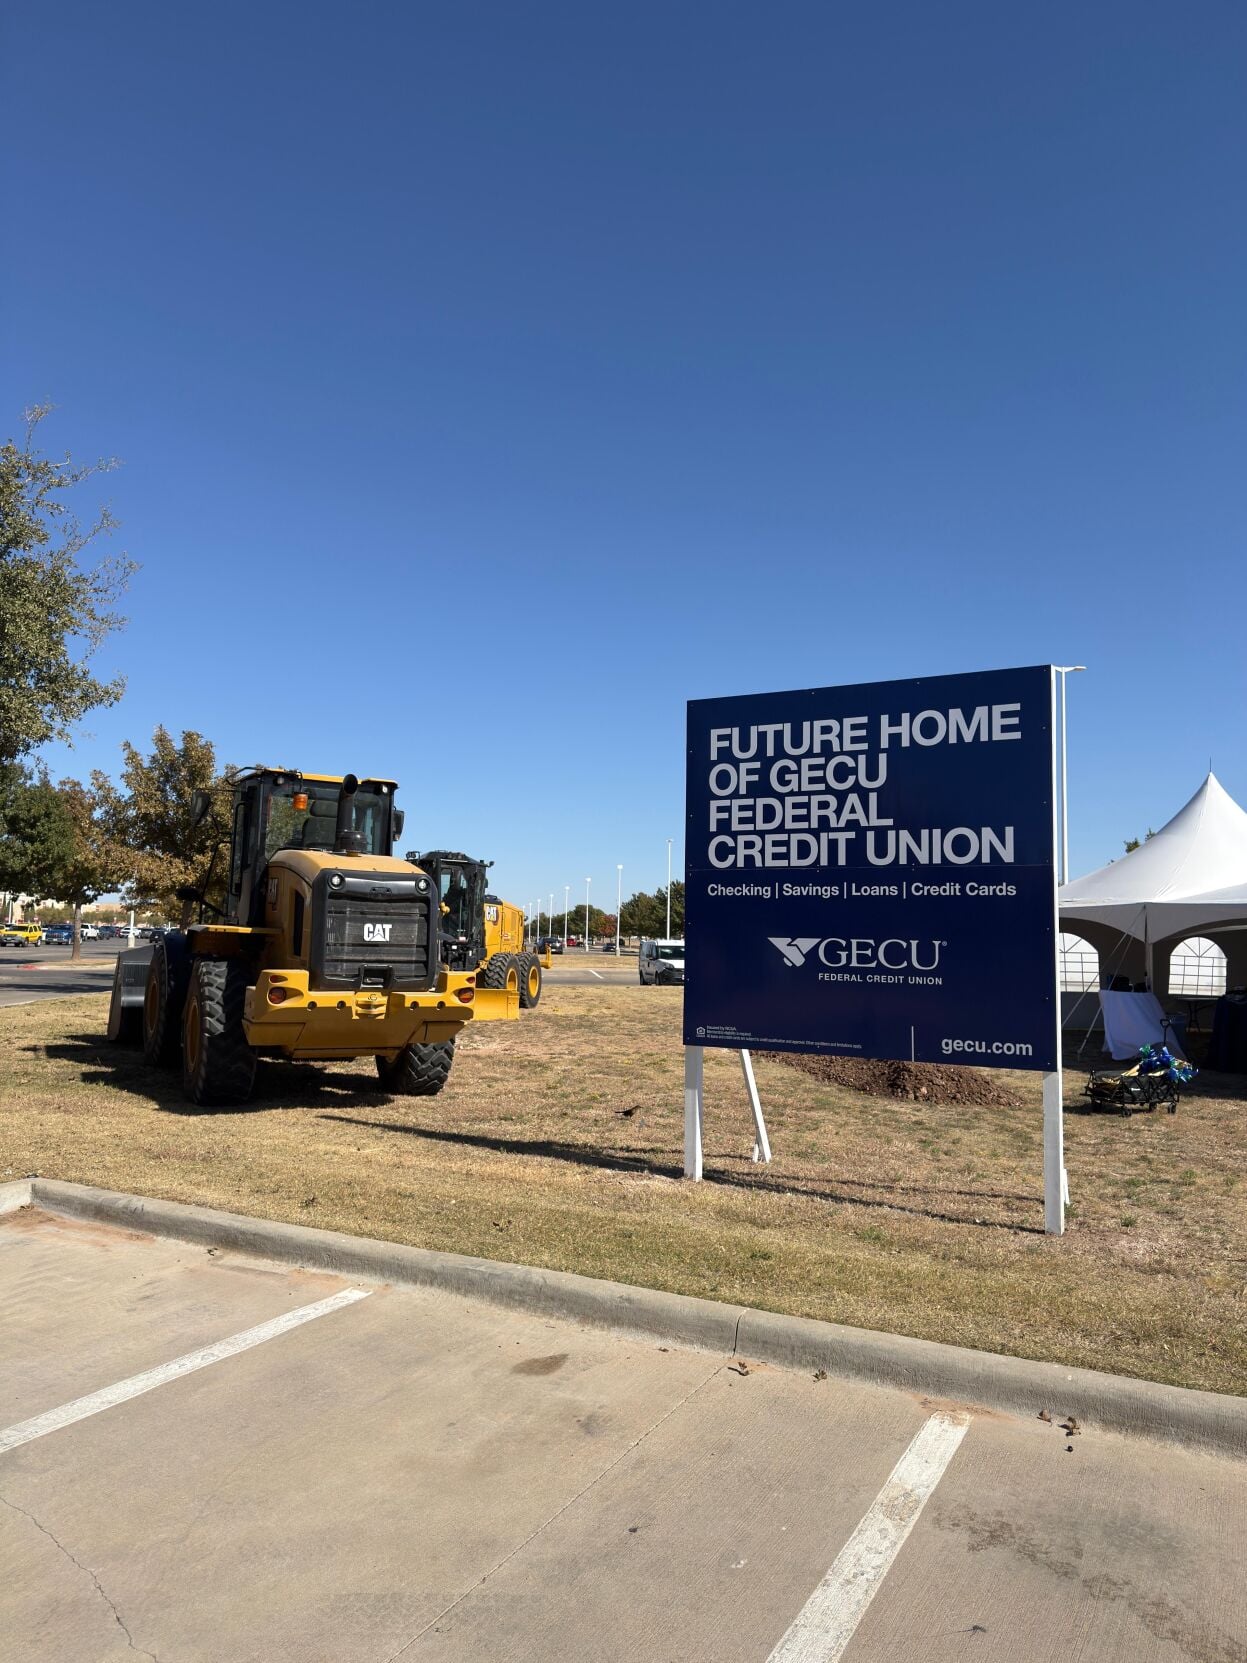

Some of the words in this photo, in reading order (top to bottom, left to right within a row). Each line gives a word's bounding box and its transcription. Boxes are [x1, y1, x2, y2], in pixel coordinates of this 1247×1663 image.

[710, 715, 870, 761] FUTURE
[881, 702, 1022, 748] HOME
[707, 761, 761, 797] OF
[769, 752, 889, 794] GECU
[709, 791, 894, 832] FEDERAL
[707, 831, 857, 869] CREDIT
[866, 825, 1015, 866] UNION
[707, 882, 772, 899] Checking
[782, 882, 840, 898] Savings
[851, 881, 899, 897] Loans
[911, 881, 962, 896] Credit
[965, 881, 1017, 896] Cards
[486, 906, 497, 921] CAT
[363, 923, 393, 942] CAT
[818, 972, 863, 983] FEDERAL
[866, 973, 904, 984] CREDIT
[908, 975, 943, 985] UNION
[941, 1038, 1033, 1056] gecu.com
